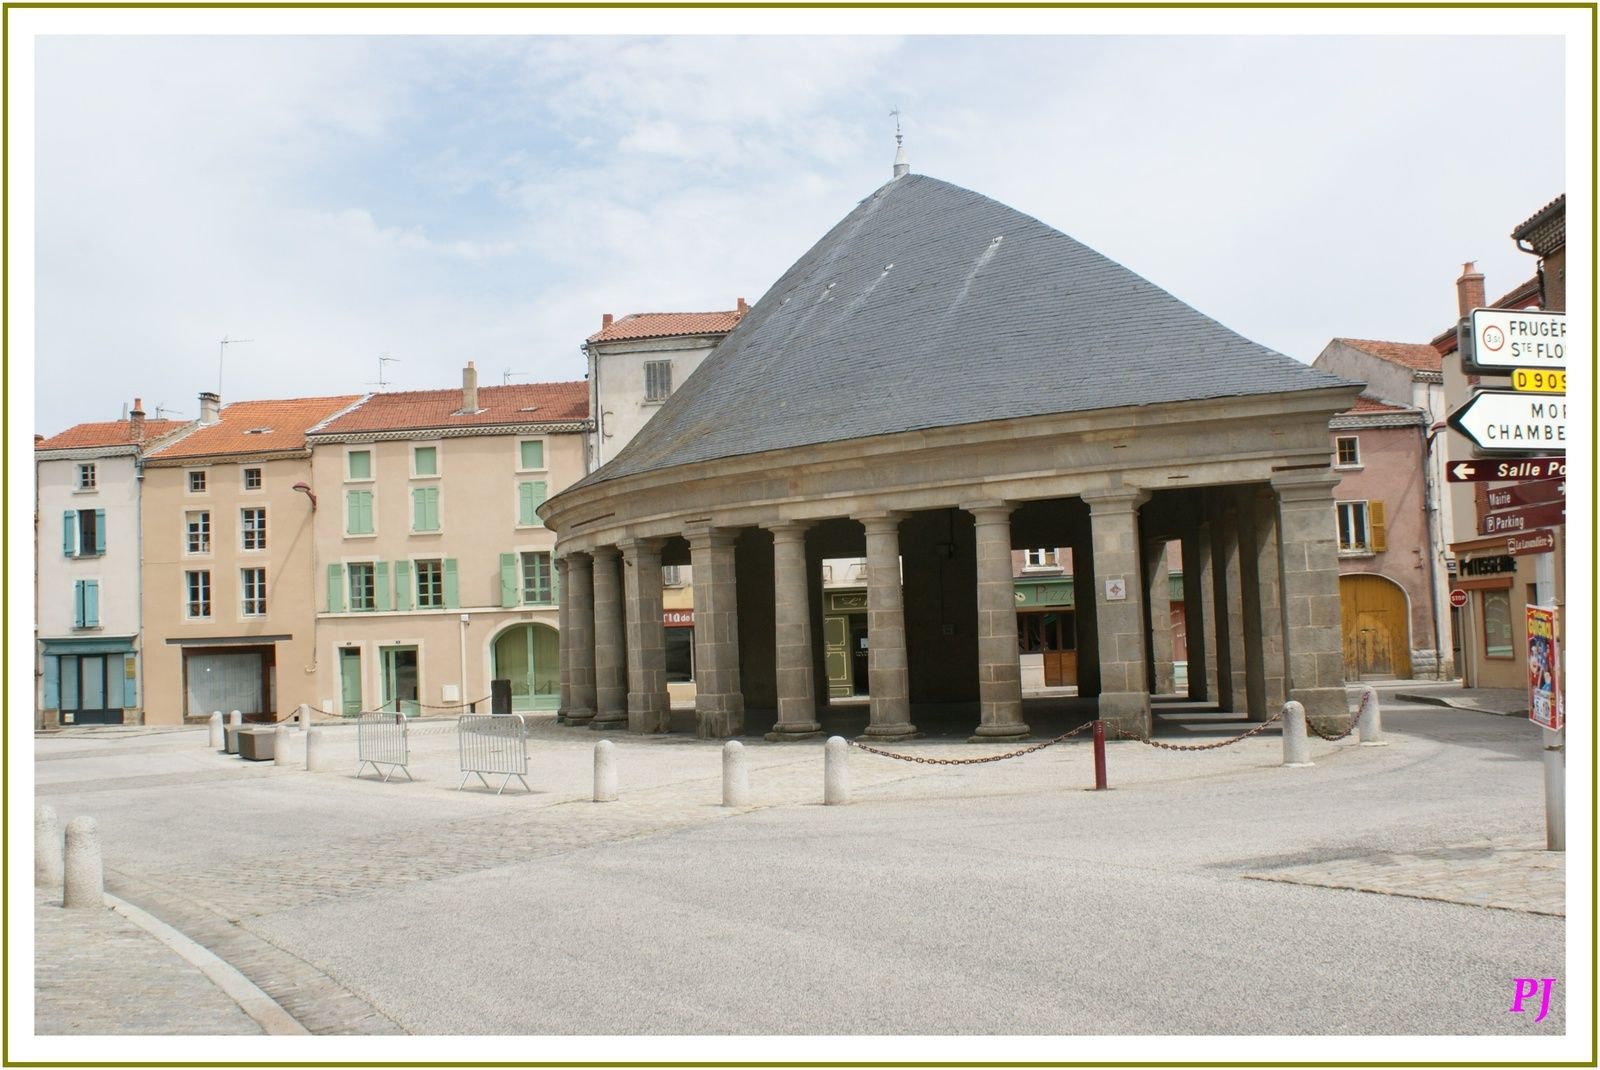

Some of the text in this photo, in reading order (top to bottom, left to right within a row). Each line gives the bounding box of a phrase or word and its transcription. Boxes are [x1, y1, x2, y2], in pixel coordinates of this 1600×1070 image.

[1537, 343, 1566, 358] FLO
[1518, 372, 1527, 387] D
[1487, 424, 1566, 440] CHAMBE
[1497, 462, 1541, 477] Salle
[1489, 491, 1511, 505] Mairie
[1496, 515, 1524, 529] Parking
